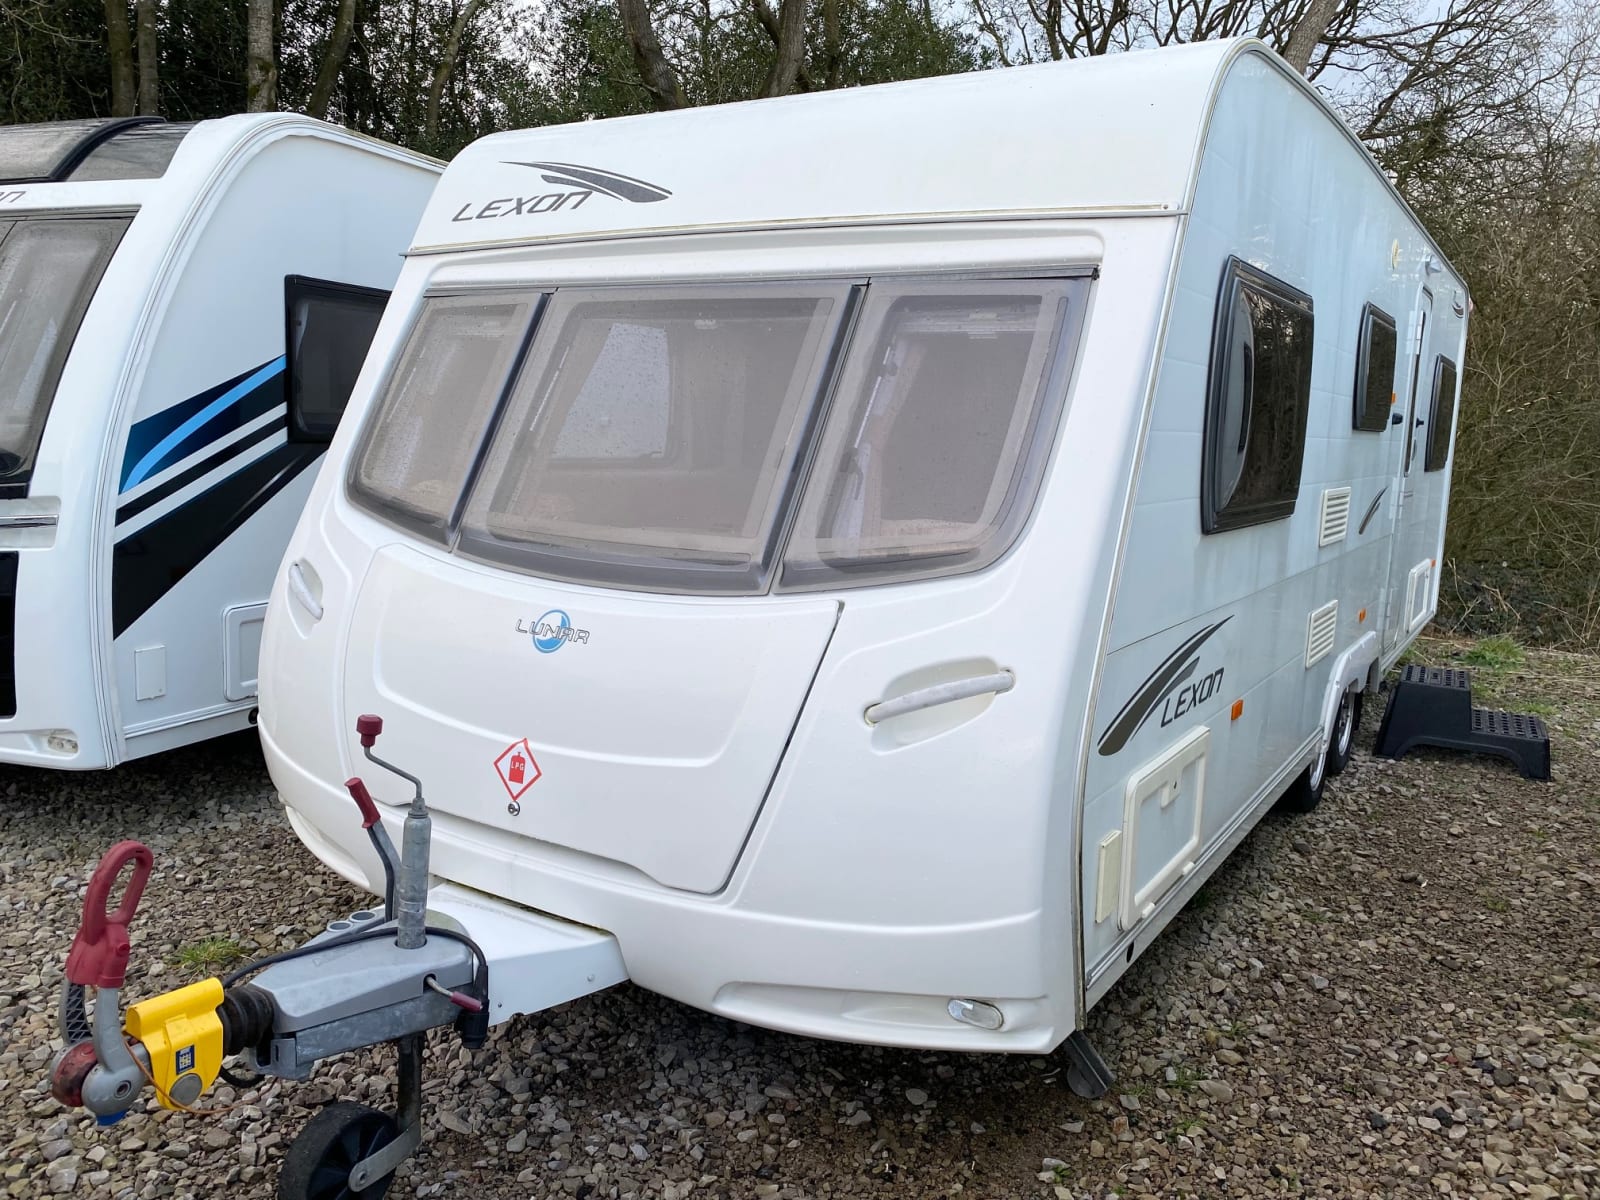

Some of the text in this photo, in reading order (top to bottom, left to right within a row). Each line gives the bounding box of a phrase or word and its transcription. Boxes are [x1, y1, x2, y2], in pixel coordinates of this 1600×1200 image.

[452, 191, 593, 222] LEXON
[515, 619, 590, 645] LUNAR
[1160, 667, 1225, 728] LEXON
[510, 760, 525, 771] LPG
